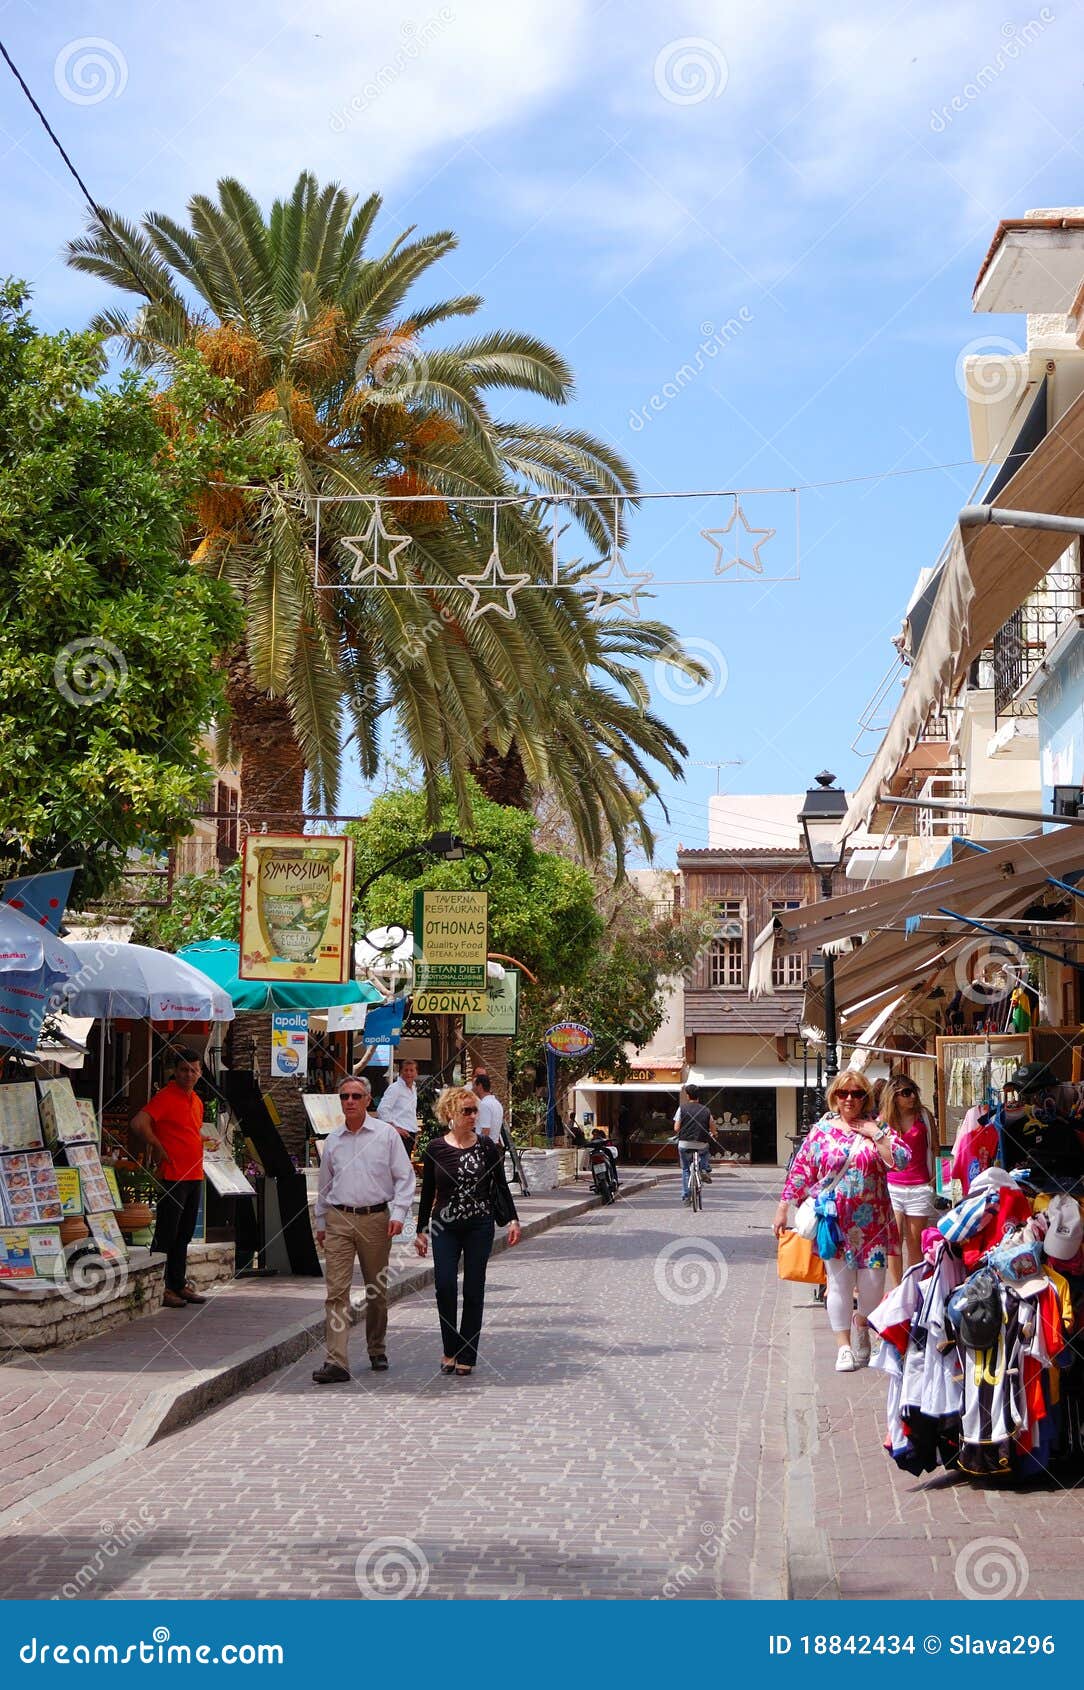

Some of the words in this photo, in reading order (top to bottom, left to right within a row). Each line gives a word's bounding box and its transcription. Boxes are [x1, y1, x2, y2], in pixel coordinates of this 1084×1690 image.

[263, 861, 331, 880] SYMPOSIUM
[435, 895, 476, 903] TAVERNA
[425, 904, 485, 913] RESTAURANT
[425, 921, 485, 935] OTHONAS
[427, 941, 459, 950] Quality
[461, 941, 483, 949] Food
[456, 950, 480, 958] HOUSE
[459, 965, 482, 974] DIET
[418, 995, 482, 1011] ΟΘΩΝΑΣ
[275, 1014, 308, 1027] apollo
[364, 1034, 391, 1044] apollo
